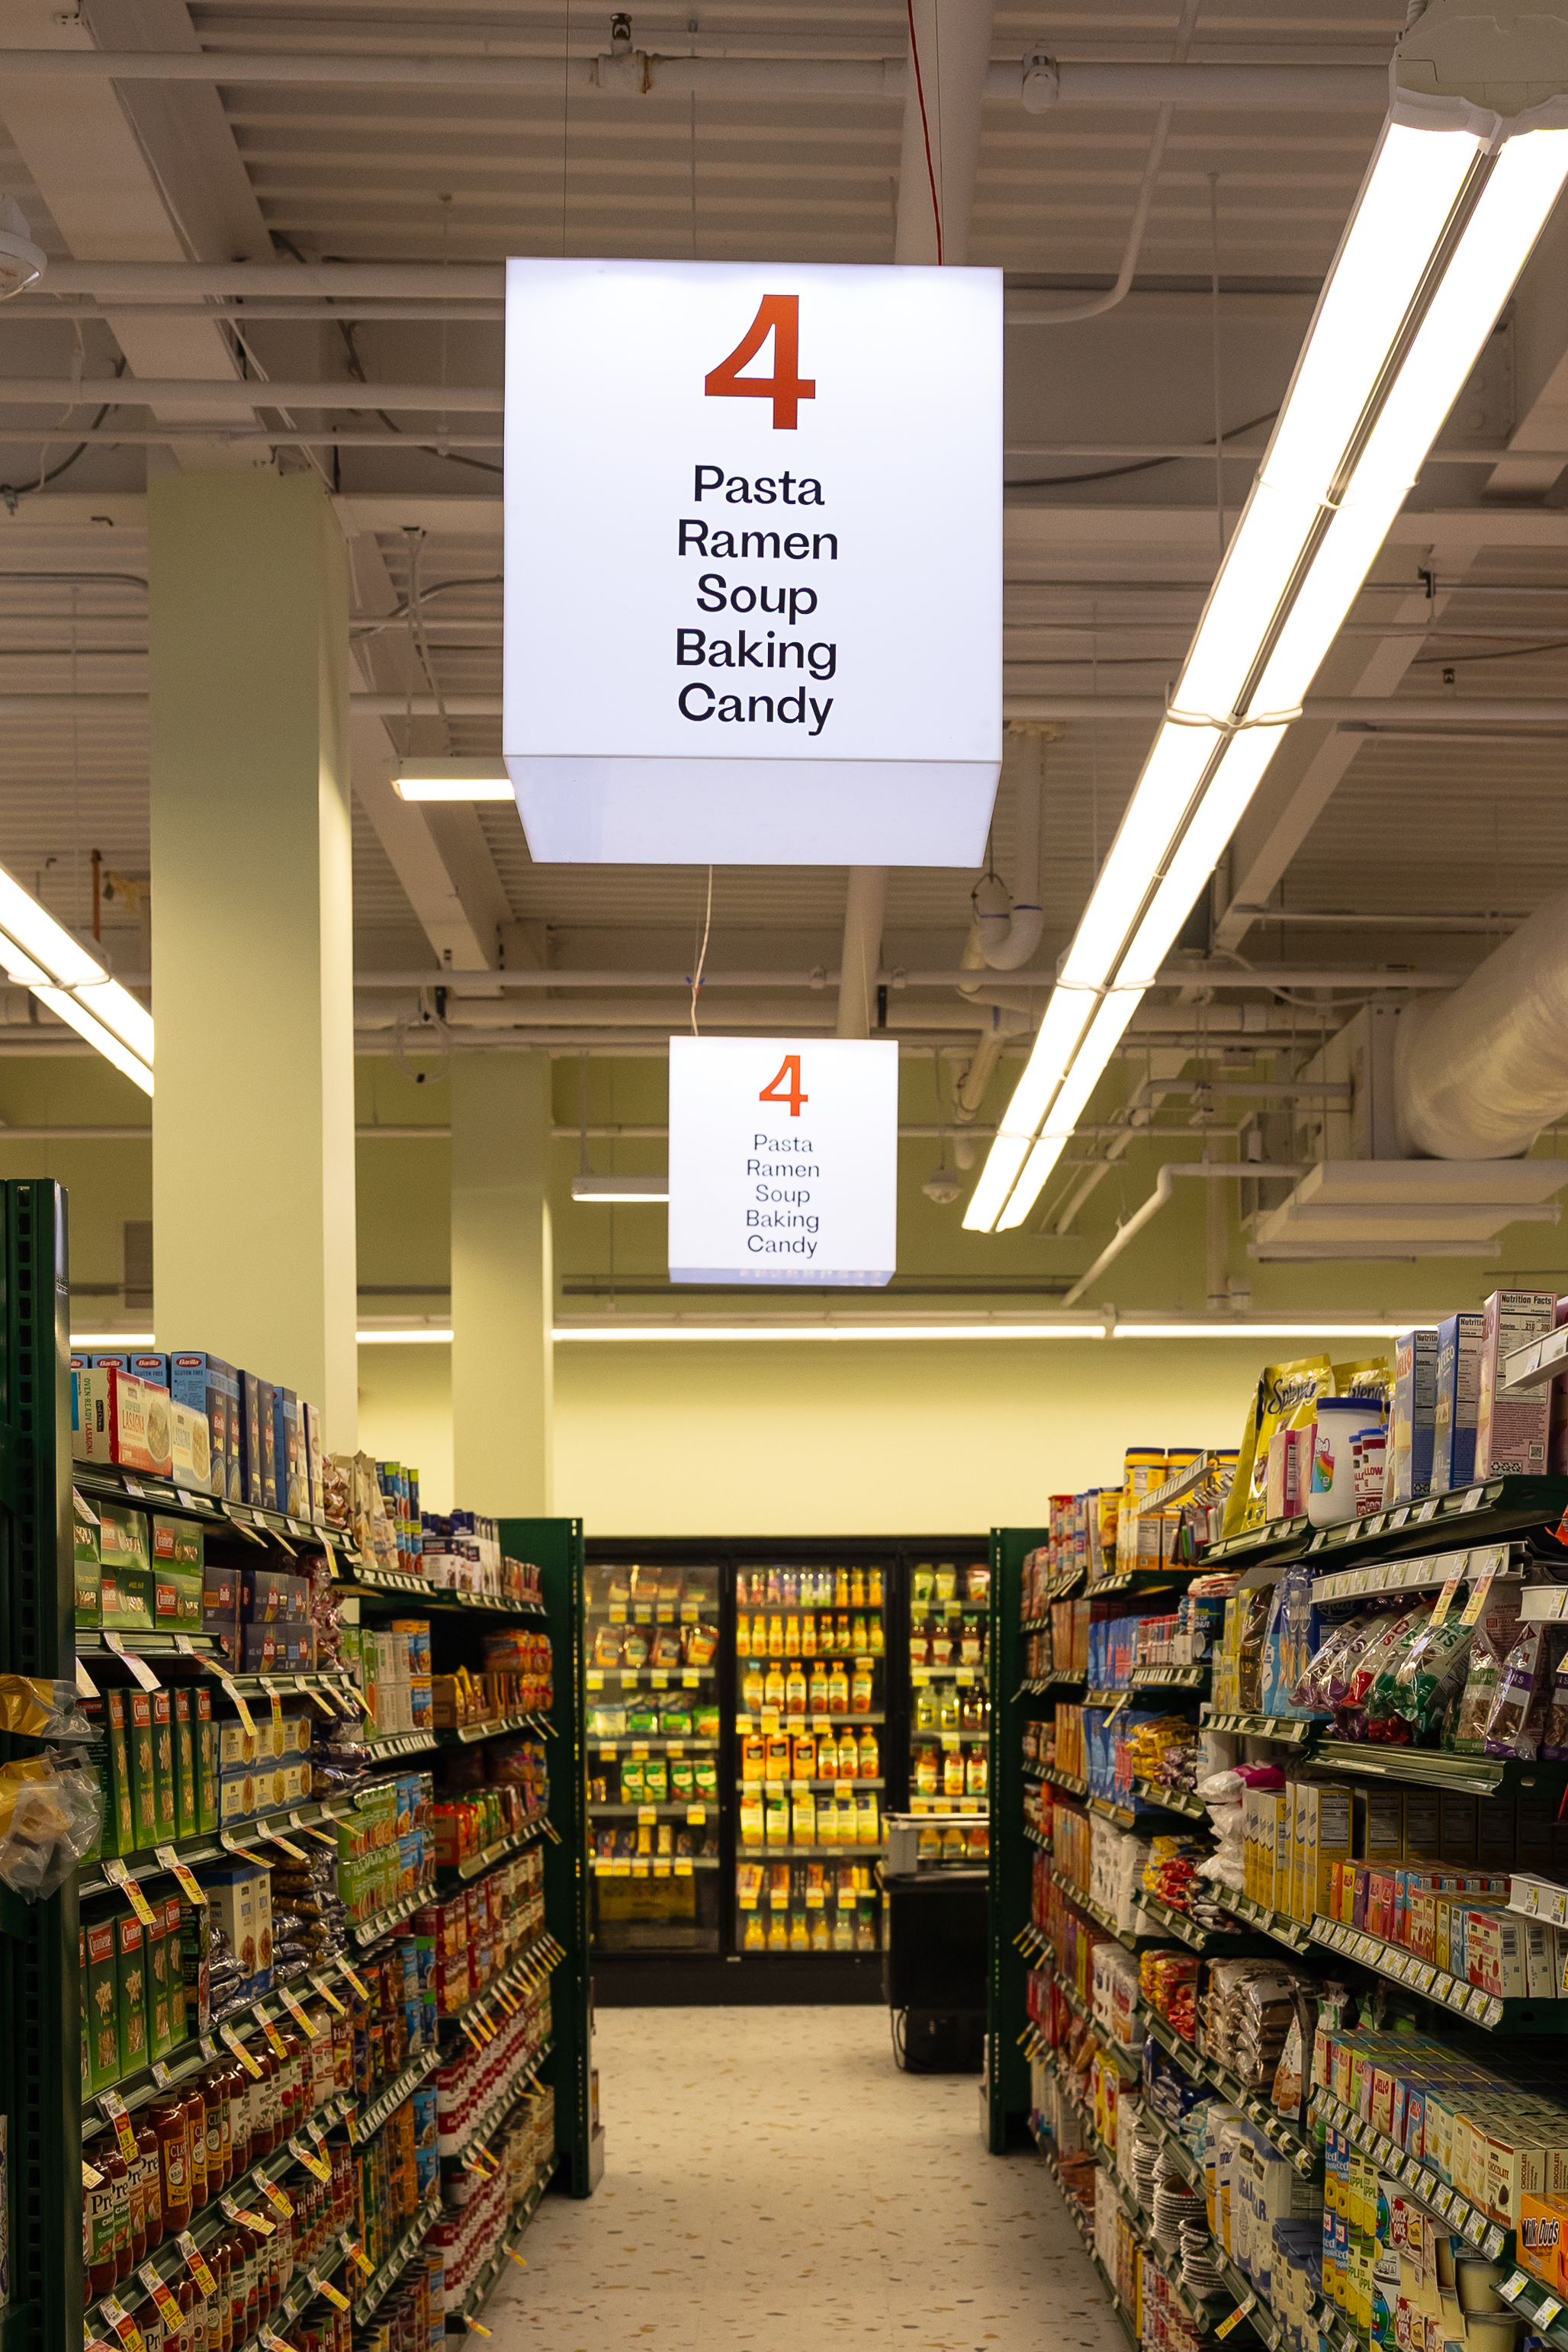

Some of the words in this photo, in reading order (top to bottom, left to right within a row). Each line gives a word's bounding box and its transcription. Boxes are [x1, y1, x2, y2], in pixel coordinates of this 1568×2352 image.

[705, 294, 815, 429] 4
[695, 465, 824, 505] Pasta
[679, 519, 837, 560] Ramen
[697, 574, 817, 625] Soup
[677, 628, 836, 680] Baking
[679, 683, 834, 736] Candy
[759, 1055, 808, 1117] 4
[754, 1134, 813, 1152] Pasta
[747, 1159, 819, 1177] Ramen
[756, 1184, 810, 1207] Soup
[747, 1210, 818, 1233] Baking
[747, 1235, 817, 1258] Candy
[1501, 1294, 1531, 1304] Nutrition
[1534, 1296, 1552, 1305] Facts
[99, 1358, 122, 1367] Barilla
[138, 1358, 160, 1367] Barilla
[178, 1357, 201, 1366] Barilla
[84, 1377, 92, 1423] OVEN-READY
[1268, 1377, 1316, 1415] Splenda
[123, 1409, 145, 1435] LASAGNA
[85, 1422, 93, 1454] LASAGNA
[141, 2156, 159, 2174] Pre
[1488, 2161, 1509, 2180] CHOCOLATE
[91, 2194, 113, 2215] Pre
[1523, 2217, 1539, 2247] Milk
[1538, 2216, 1560, 2247] Duds
